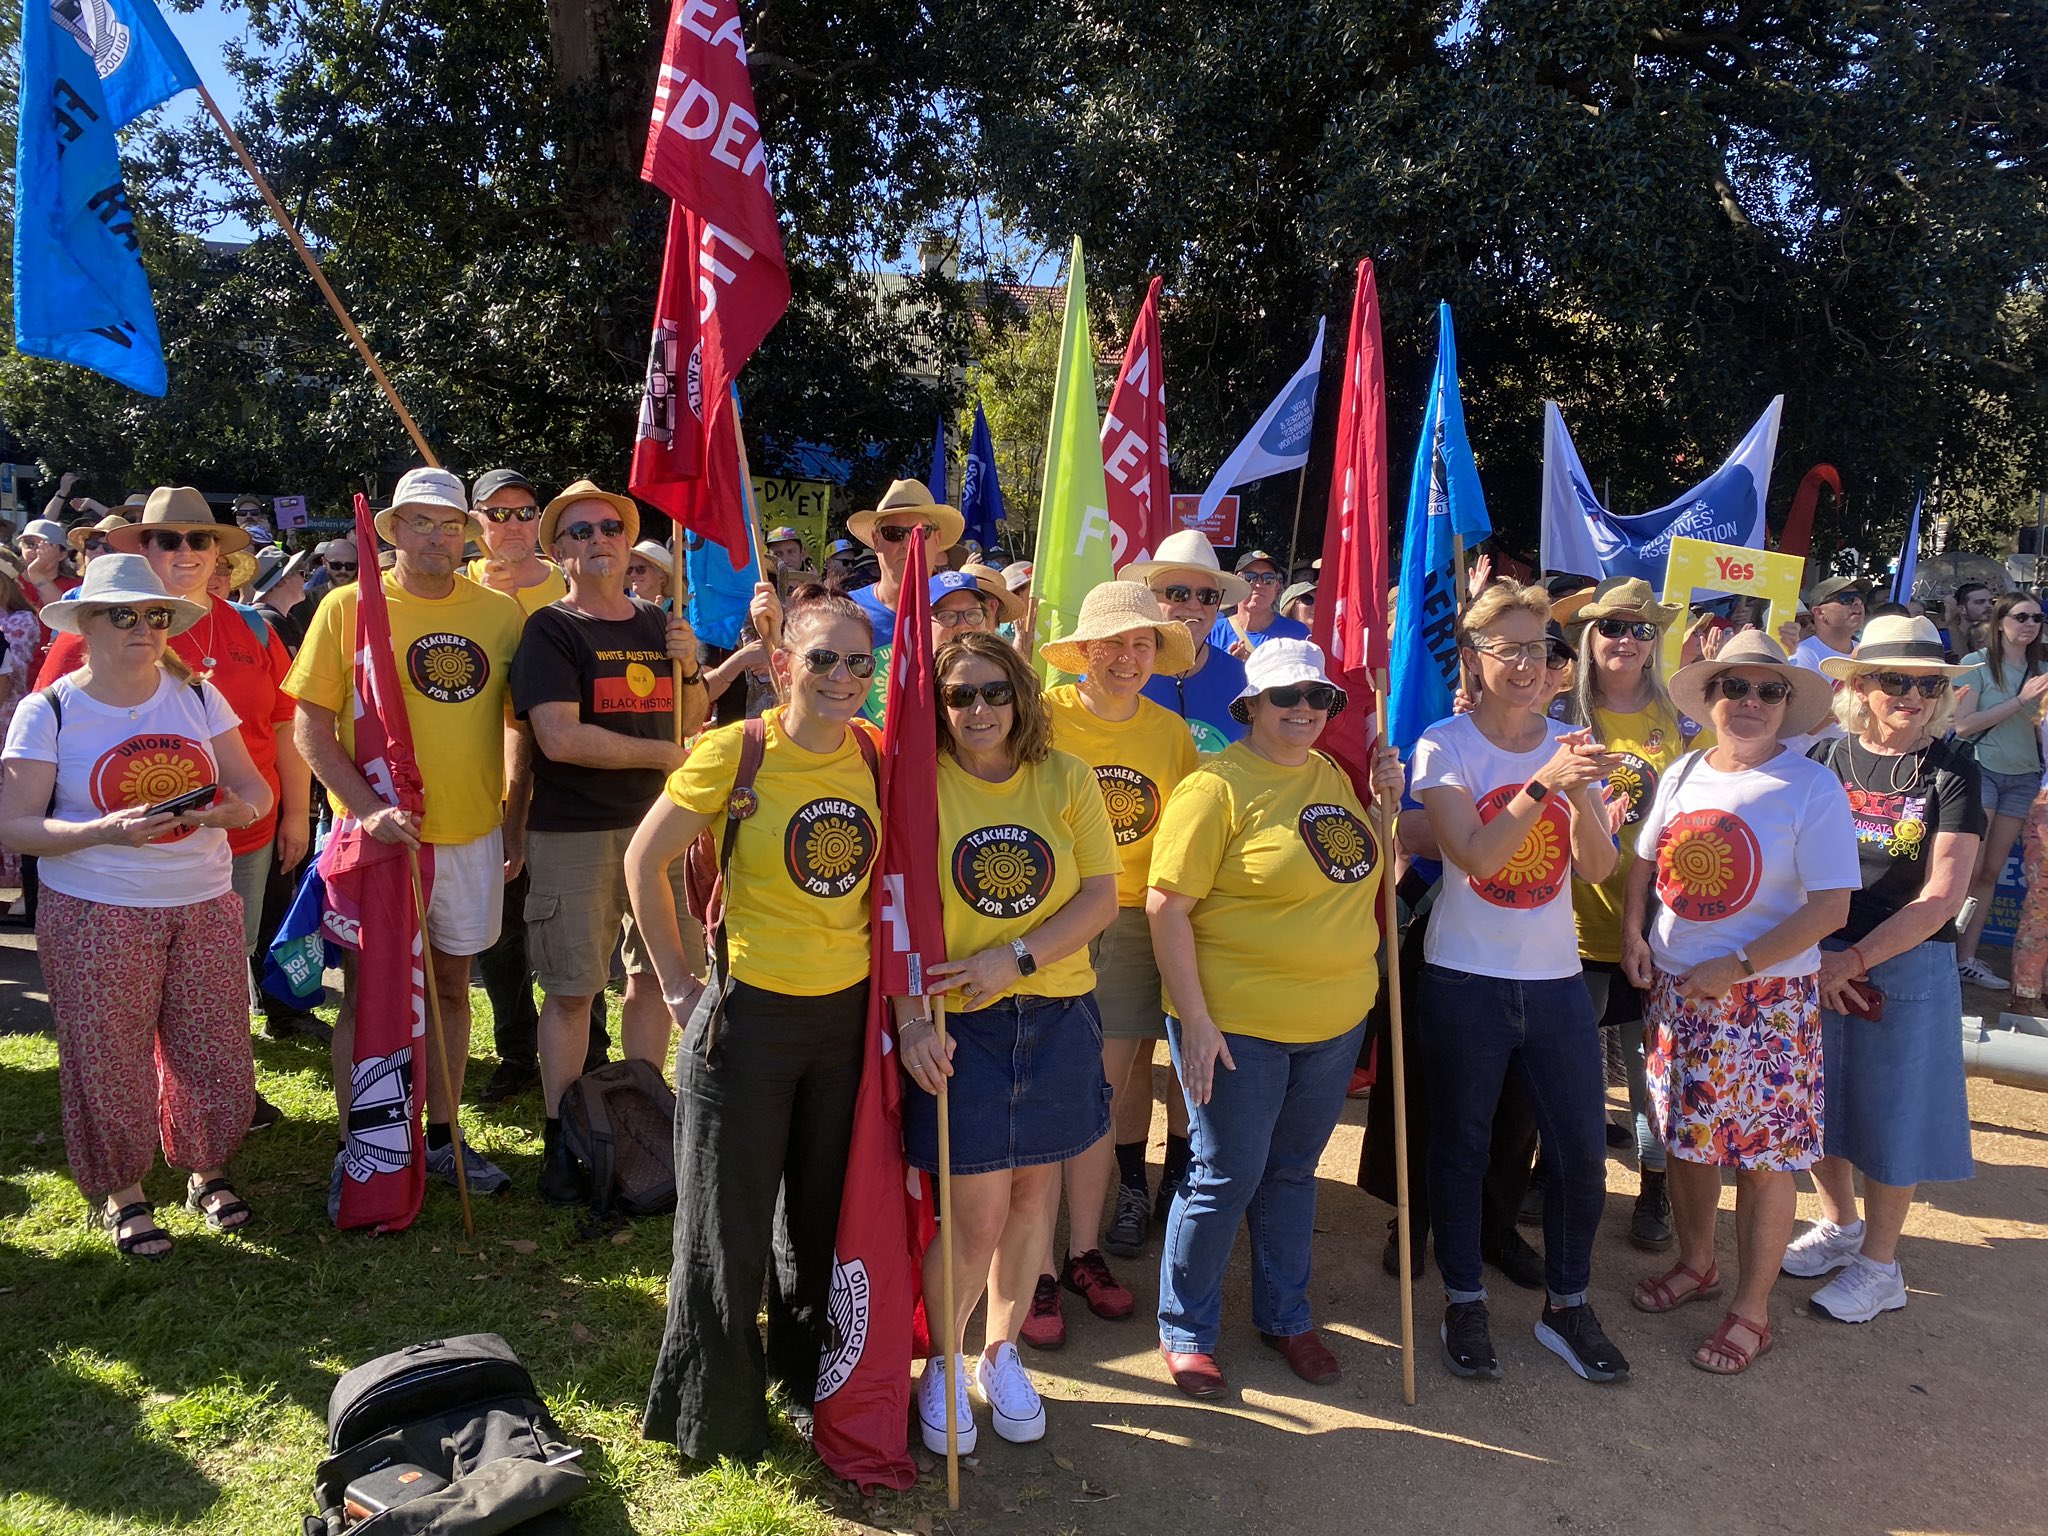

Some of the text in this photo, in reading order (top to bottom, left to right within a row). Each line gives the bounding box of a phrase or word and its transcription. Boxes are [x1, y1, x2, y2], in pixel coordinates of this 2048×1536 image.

[754, 481, 825, 516] DNEY
[1696, 500, 1708, 511] &
[308, 520, 338, 528] Redfern
[1715, 556, 1754, 581] Yes
[416, 635, 467, 650] TEACHERS
[596, 650, 668, 661] WHITE AUSTRAL
[428, 685, 475, 700] FOR YES
[601, 697, 673, 710] BLACK HISTOR
[117, 738, 181, 757] UNIONS
[731, 797, 751, 810] Yes
[800, 801, 857, 824] TEACHERS
[1848, 790, 1927, 822] OICE
[1302, 805, 1346, 823] TEACHERS
[1625, 810, 1640, 822] ES
[1683, 815, 1738, 832] UNIONS
[966, 828, 1028, 848] TEACHERS
[1116, 829, 1138, 843] YES
[1329, 860, 1370, 880] FOR YES
[805, 872, 856, 895] FOR YES
[1483, 881, 1554, 903] FOR YES
[976, 894, 1036, 915] FOR YES
[1697, 900, 1726, 917] YES
[283, 955, 306, 973] FOR
[291, 964, 310, 985] AEU
